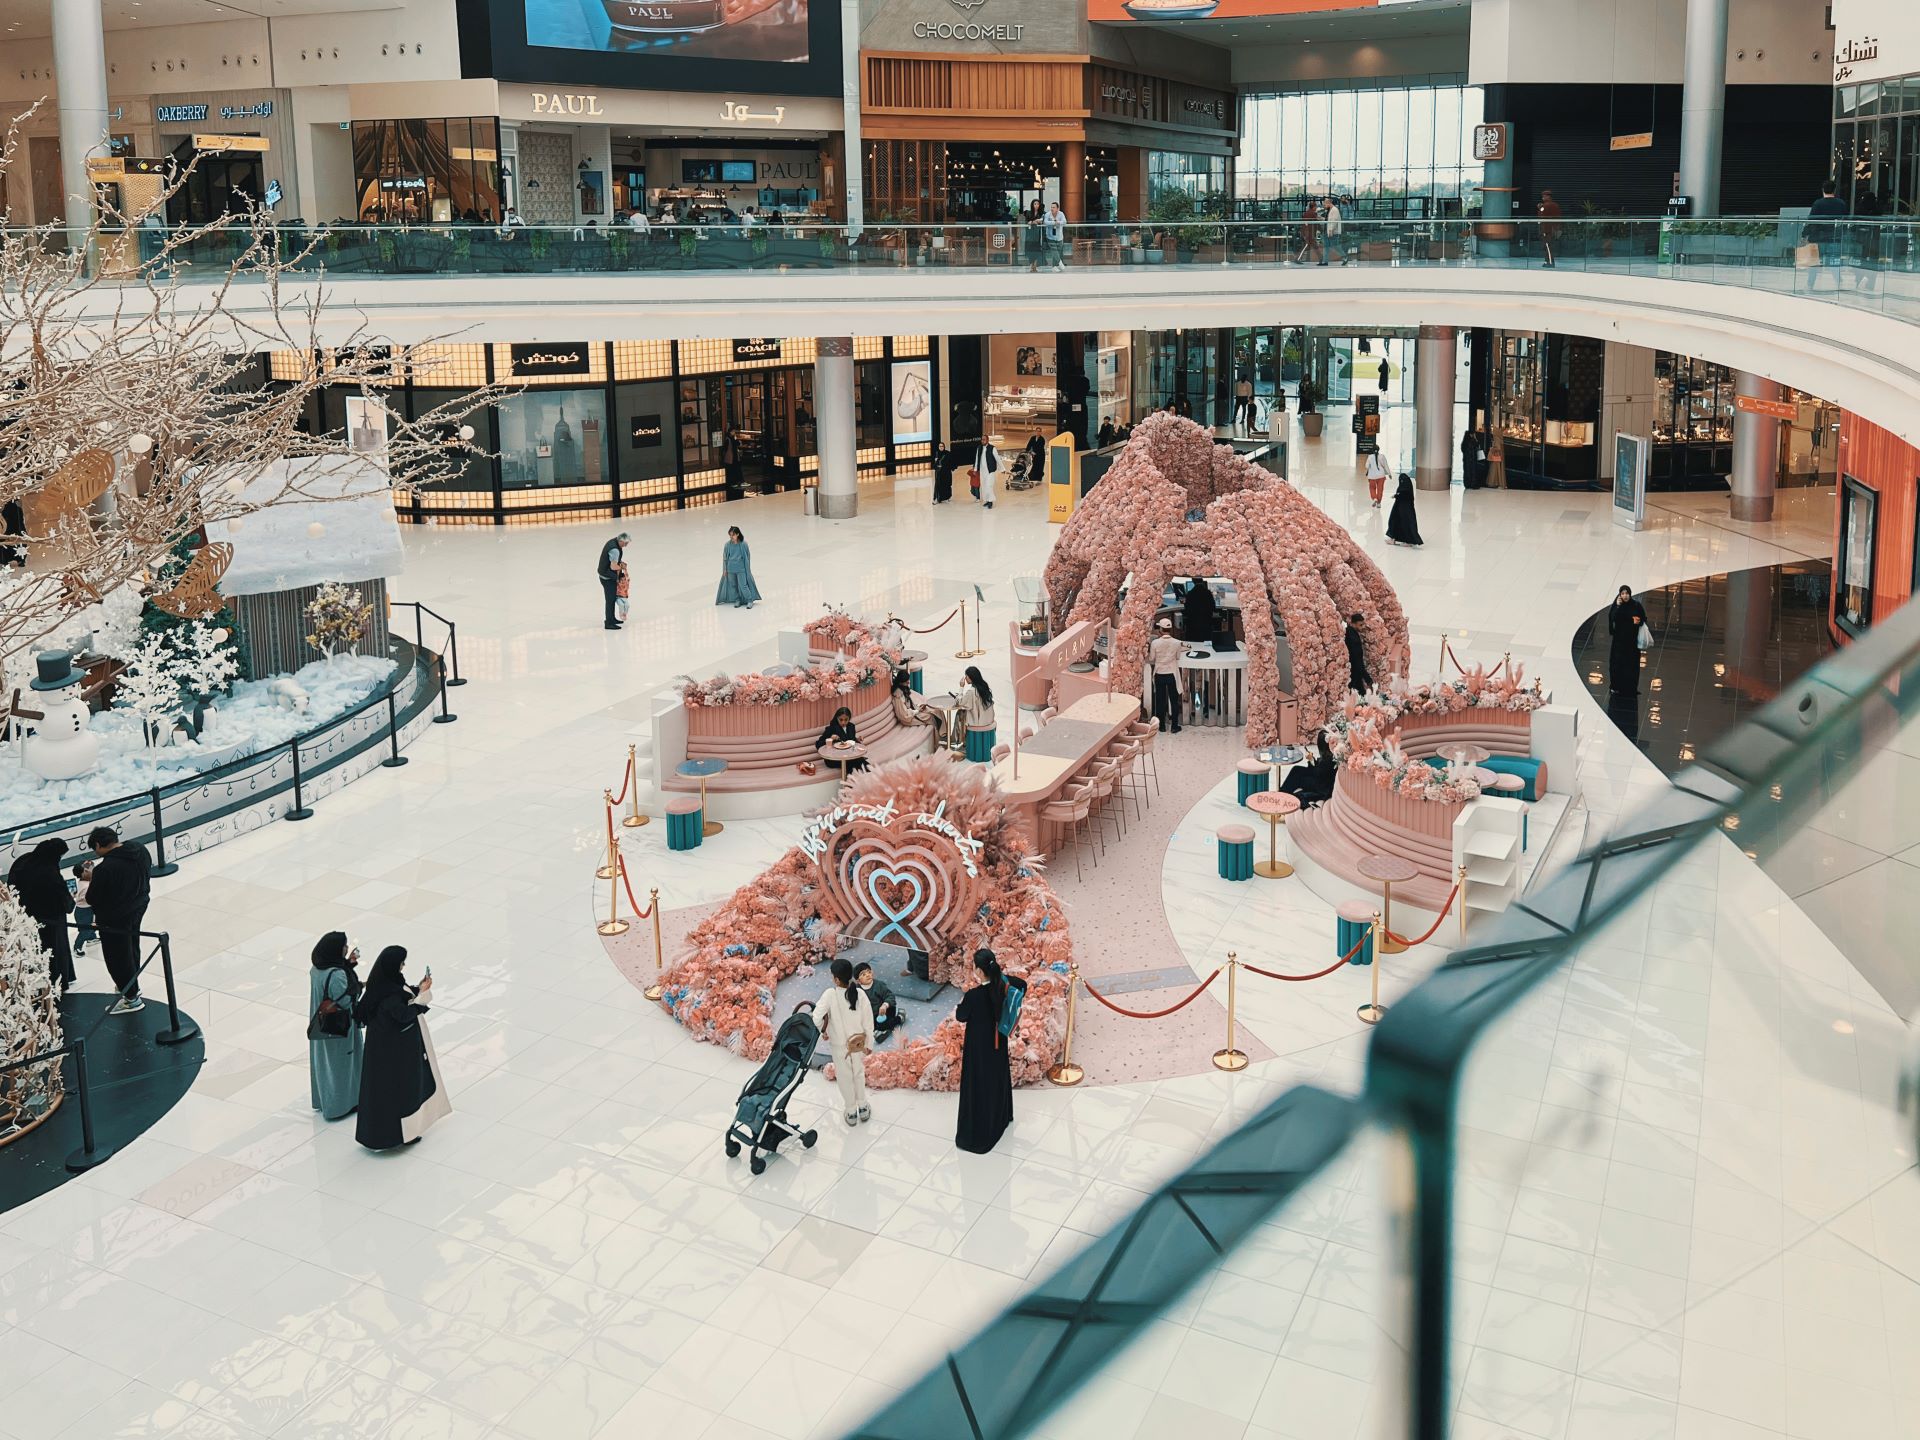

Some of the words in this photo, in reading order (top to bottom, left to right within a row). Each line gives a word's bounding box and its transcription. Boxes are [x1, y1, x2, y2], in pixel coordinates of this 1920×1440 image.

[628, 6, 673, 17] PAUL
[913, 21, 1024, 40] CHOCOMELT
[531, 93, 604, 116] PAUL
[157, 105, 208, 122] OAKBERRY
[759, 162, 817, 179] PAUL
[521, 351, 580, 365] كوتش
[1738, 398, 1744, 408] G
[846, 799, 899, 827] sweet
